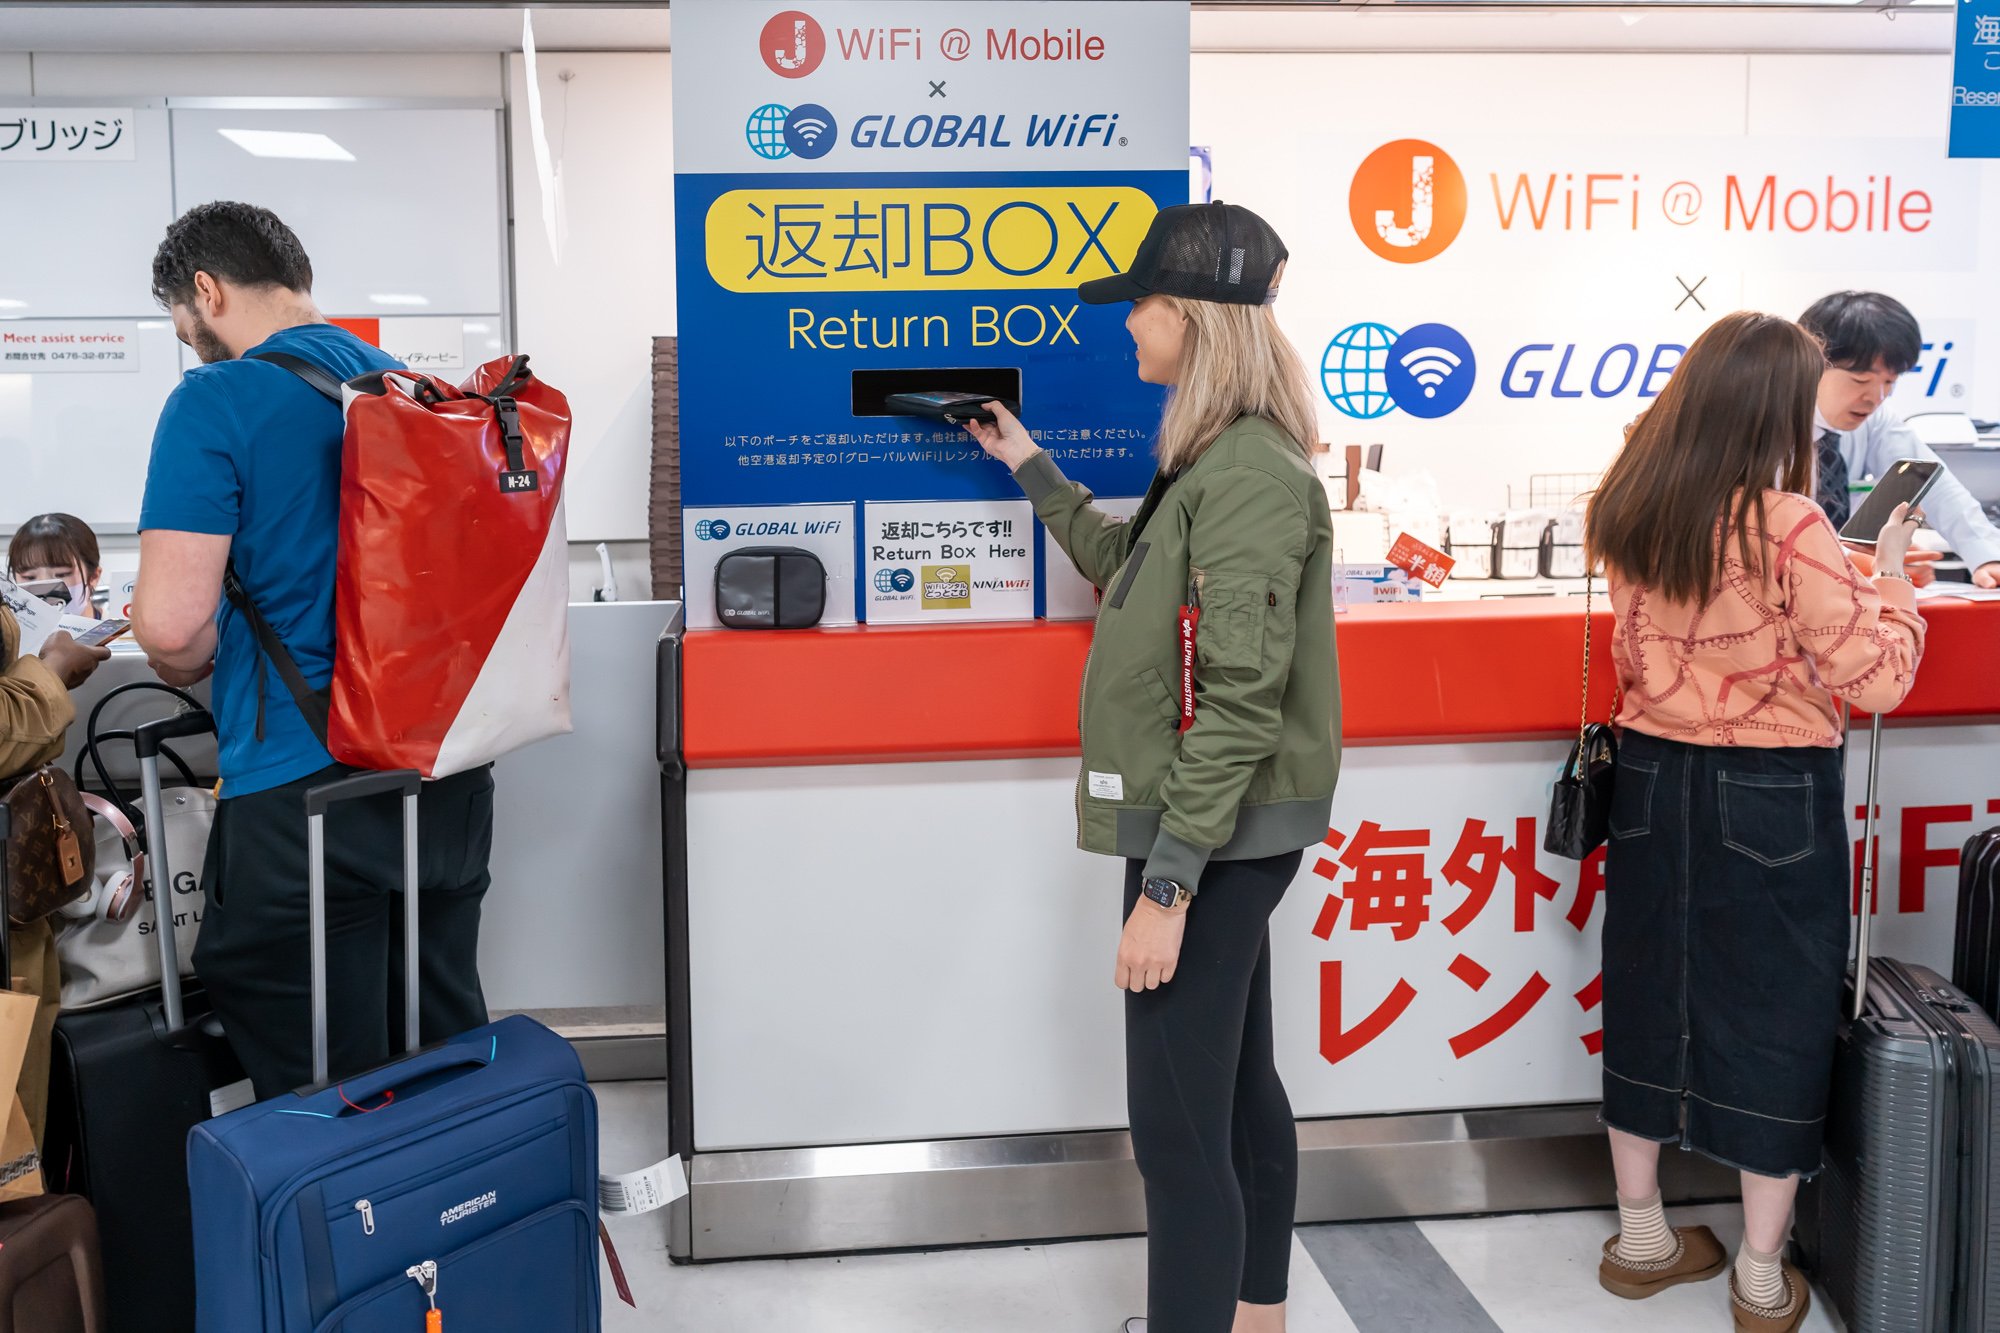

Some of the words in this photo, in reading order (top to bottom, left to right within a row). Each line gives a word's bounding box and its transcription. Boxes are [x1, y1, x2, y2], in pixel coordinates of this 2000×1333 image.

[837, 28, 921, 61] WiFi
[986, 28, 1105, 61] Mobile
[0, 118, 122, 151] ブリッジ
[850, 114, 1011, 148] GLOBAL
[1489, 173, 1641, 232] WiFi
[1724, 174, 1933, 233] Mobile
[745, 200, 1121, 280] 返却BOX
[4, 333, 36, 343] Meet
[41, 332, 75, 343] assist
[79, 332, 125, 343] service
[788, 308, 949, 350] Return
[971, 304, 1080, 347] BOX
[394, 352, 458, 362] ェイティービー
[1500, 343, 1687, 398] GLOB
[735, 522, 799, 536] GLOBAL
[804, 521, 841, 534] WiFi
[872, 545, 931, 561] Return
[941, 544, 976, 559] Box
[989, 544, 1026, 558] Here
[1408, 554, 1447, 586] 半額
[925, 589, 967, 597] どっとこむ
[1184, 639, 1193, 666] ALPHA
[1184, 668, 1193, 717] INDUSTRIES
[1311, 817, 1606, 942] 海外
[1319, 952, 1604, 1066] レン
[440, 1190, 496, 1219] AMERICAN
[440, 1197, 497, 1226] TOURISTER
